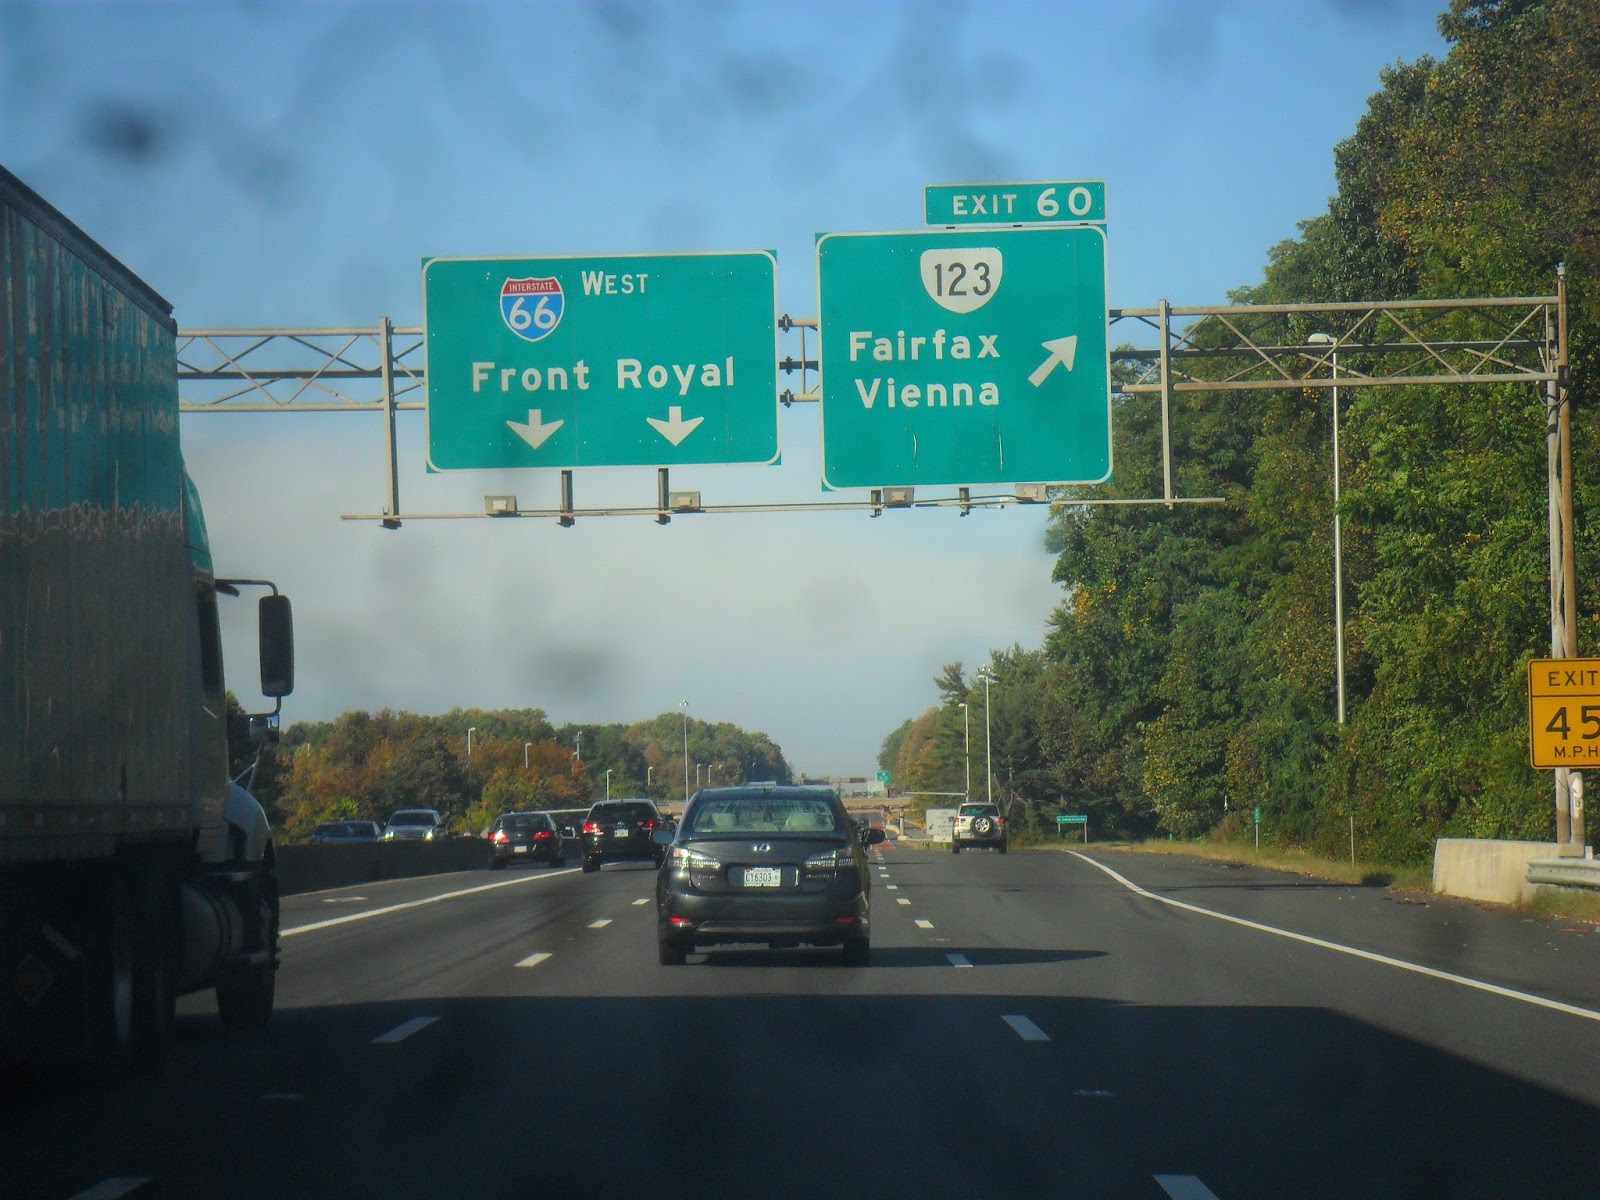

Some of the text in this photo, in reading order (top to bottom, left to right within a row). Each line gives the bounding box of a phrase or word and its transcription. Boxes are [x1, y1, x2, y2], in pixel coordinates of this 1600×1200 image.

[953, 187, 1092, 216] EXIT 60
[509, 281, 554, 292] INTERSTATE
[581, 270, 648, 295] WEST
[934, 262, 991, 296] 123
[509, 296, 556, 330] 66
[849, 329, 1000, 362] Fairfax
[472, 356, 734, 395] Front Royal
[855, 378, 999, 409] Vienna
[1548, 670, 1598, 687] EXIT
[1545, 705, 1600, 740] 45
